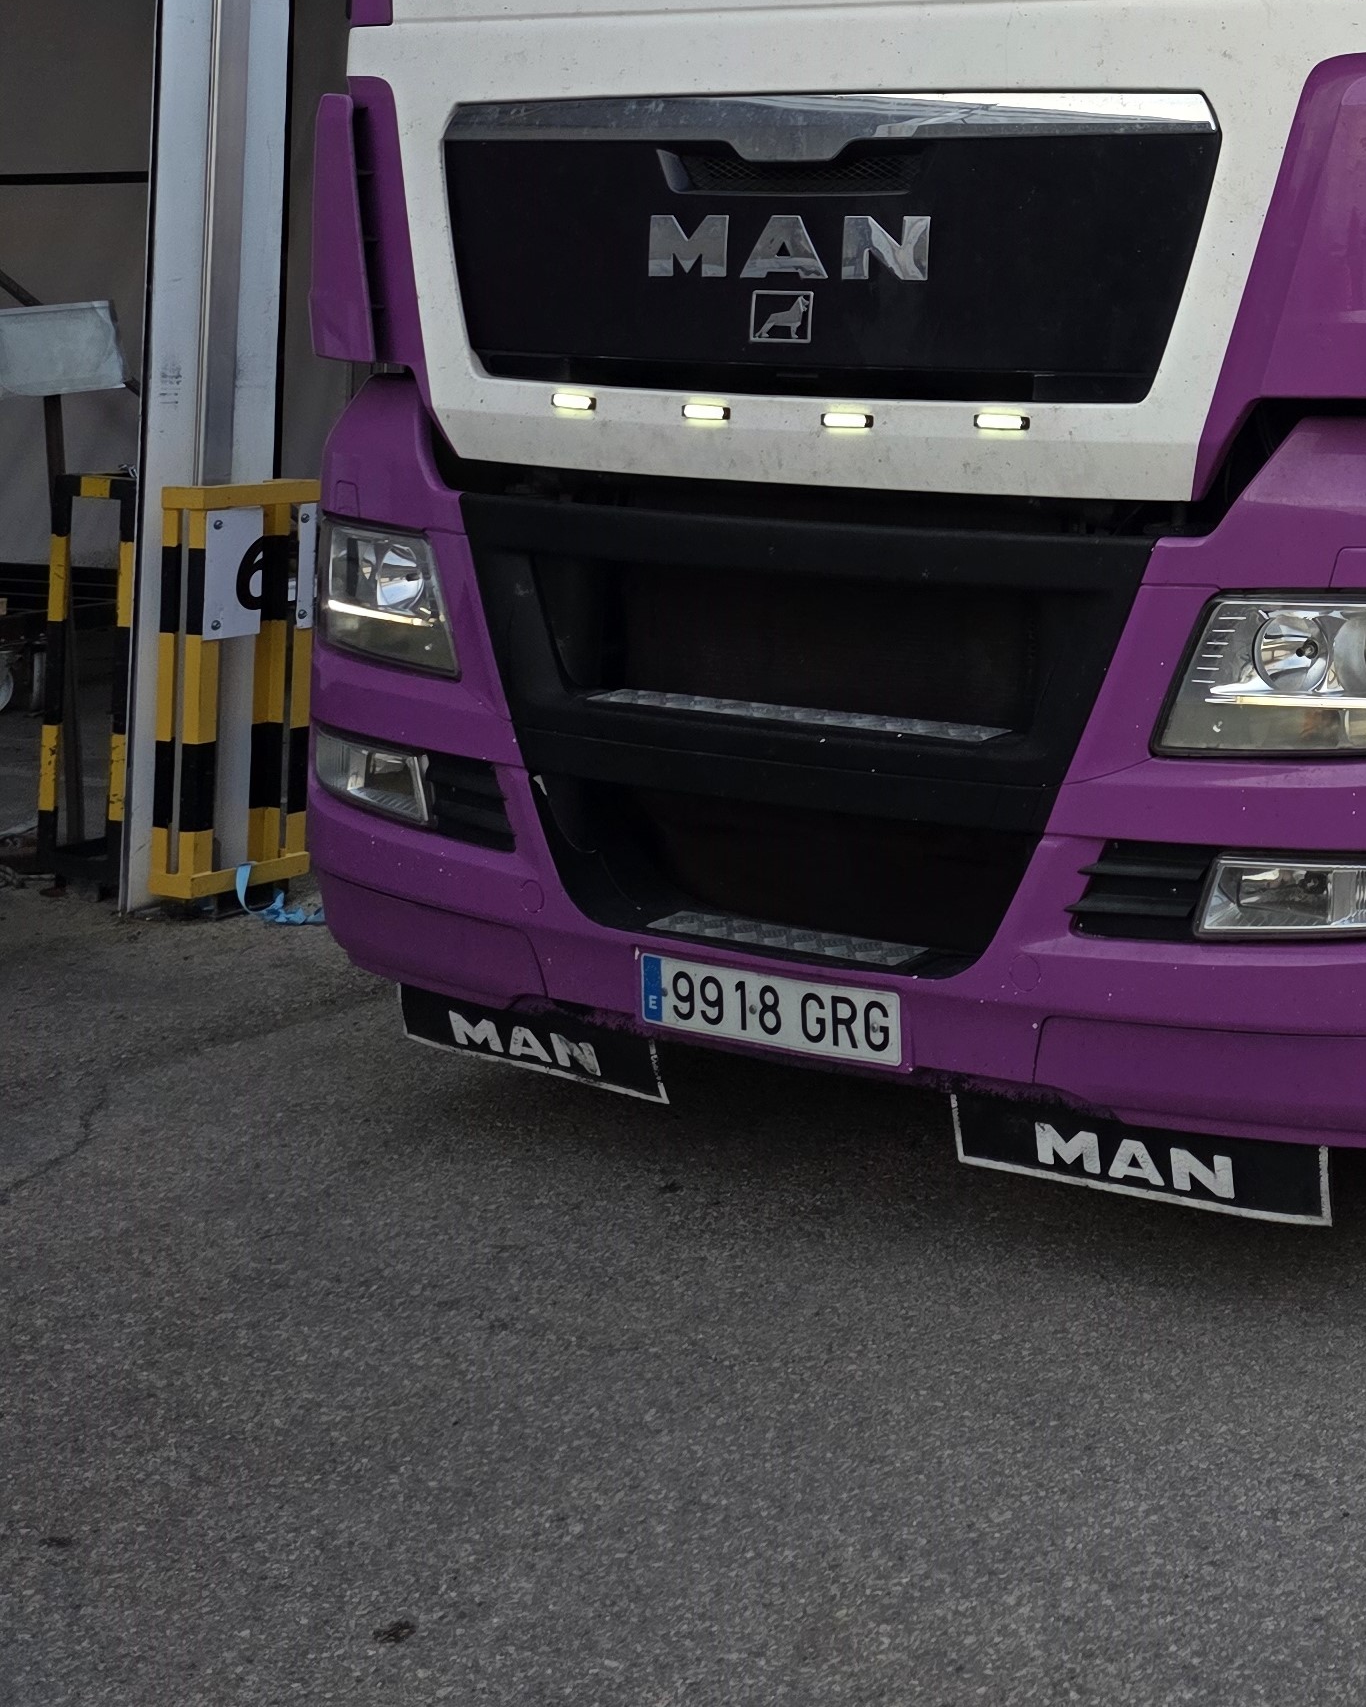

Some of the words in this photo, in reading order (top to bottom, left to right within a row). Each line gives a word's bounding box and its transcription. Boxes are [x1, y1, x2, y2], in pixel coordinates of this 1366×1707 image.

[648, 214, 932, 281] MAN
[648, 995, 658, 1010] E
[672, 970, 782, 1036] 9918
[800, 992, 890, 1052] GRG
[448, 1009, 602, 1077] MAN
[1034, 1121, 1236, 1200] MAN
